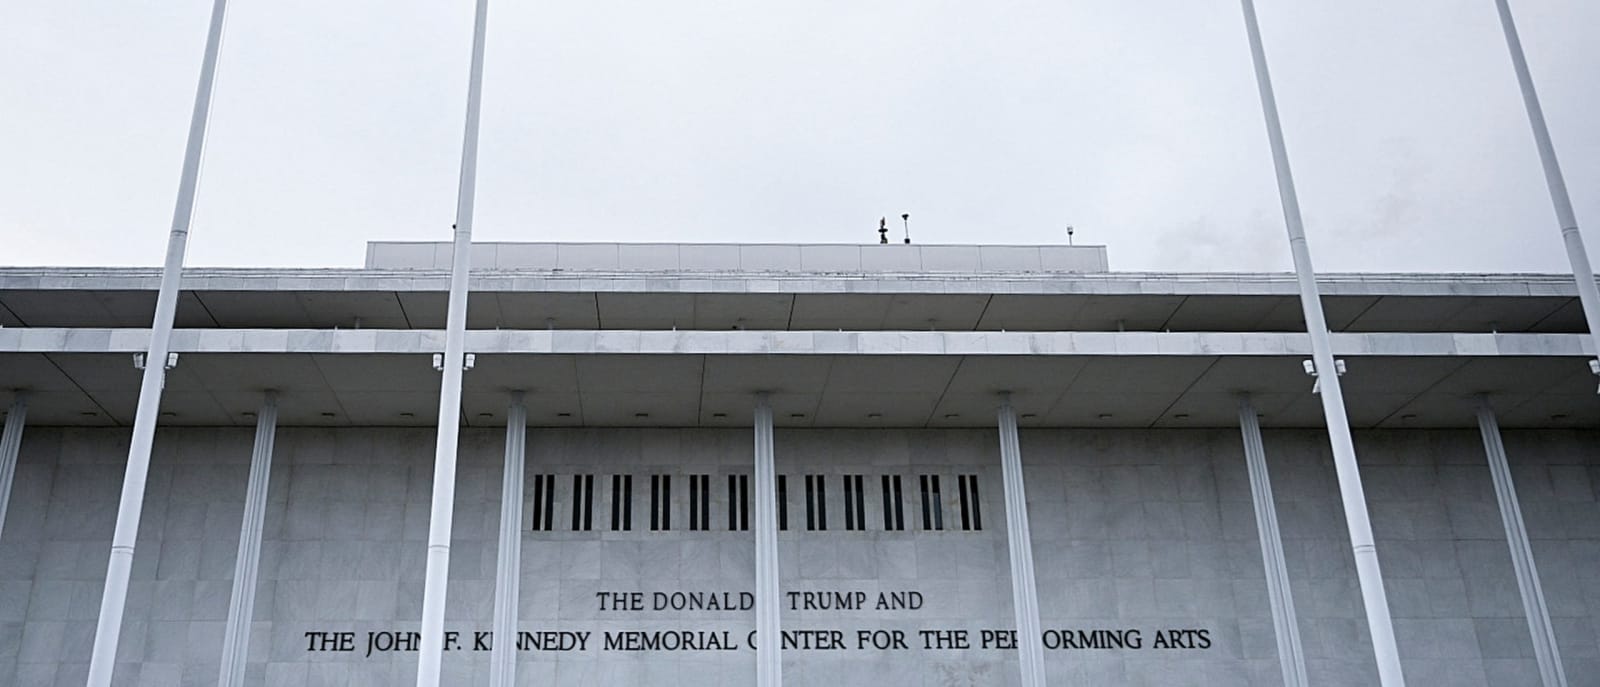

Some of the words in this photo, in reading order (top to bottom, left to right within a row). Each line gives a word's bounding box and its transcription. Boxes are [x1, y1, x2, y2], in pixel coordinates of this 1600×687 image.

[595, 591, 645, 611] THE
[653, 591, 755, 611] DONALD
[786, 591, 866, 610] TRUMP
[875, 591, 923, 610] AND
[304, 631, 356, 651] THE
[443, 631, 462, 651] F.
[473, 631, 591, 651] KNEDY
[603, 631, 738, 651] MEMORIAL
[747, 629, 847, 651] CNTER
[856, 630, 909, 650] FOR
[918, 630, 970, 650] THE
[980, 629, 1143, 650] PEORMING
[1152, 629, 1212, 650] ARTS
